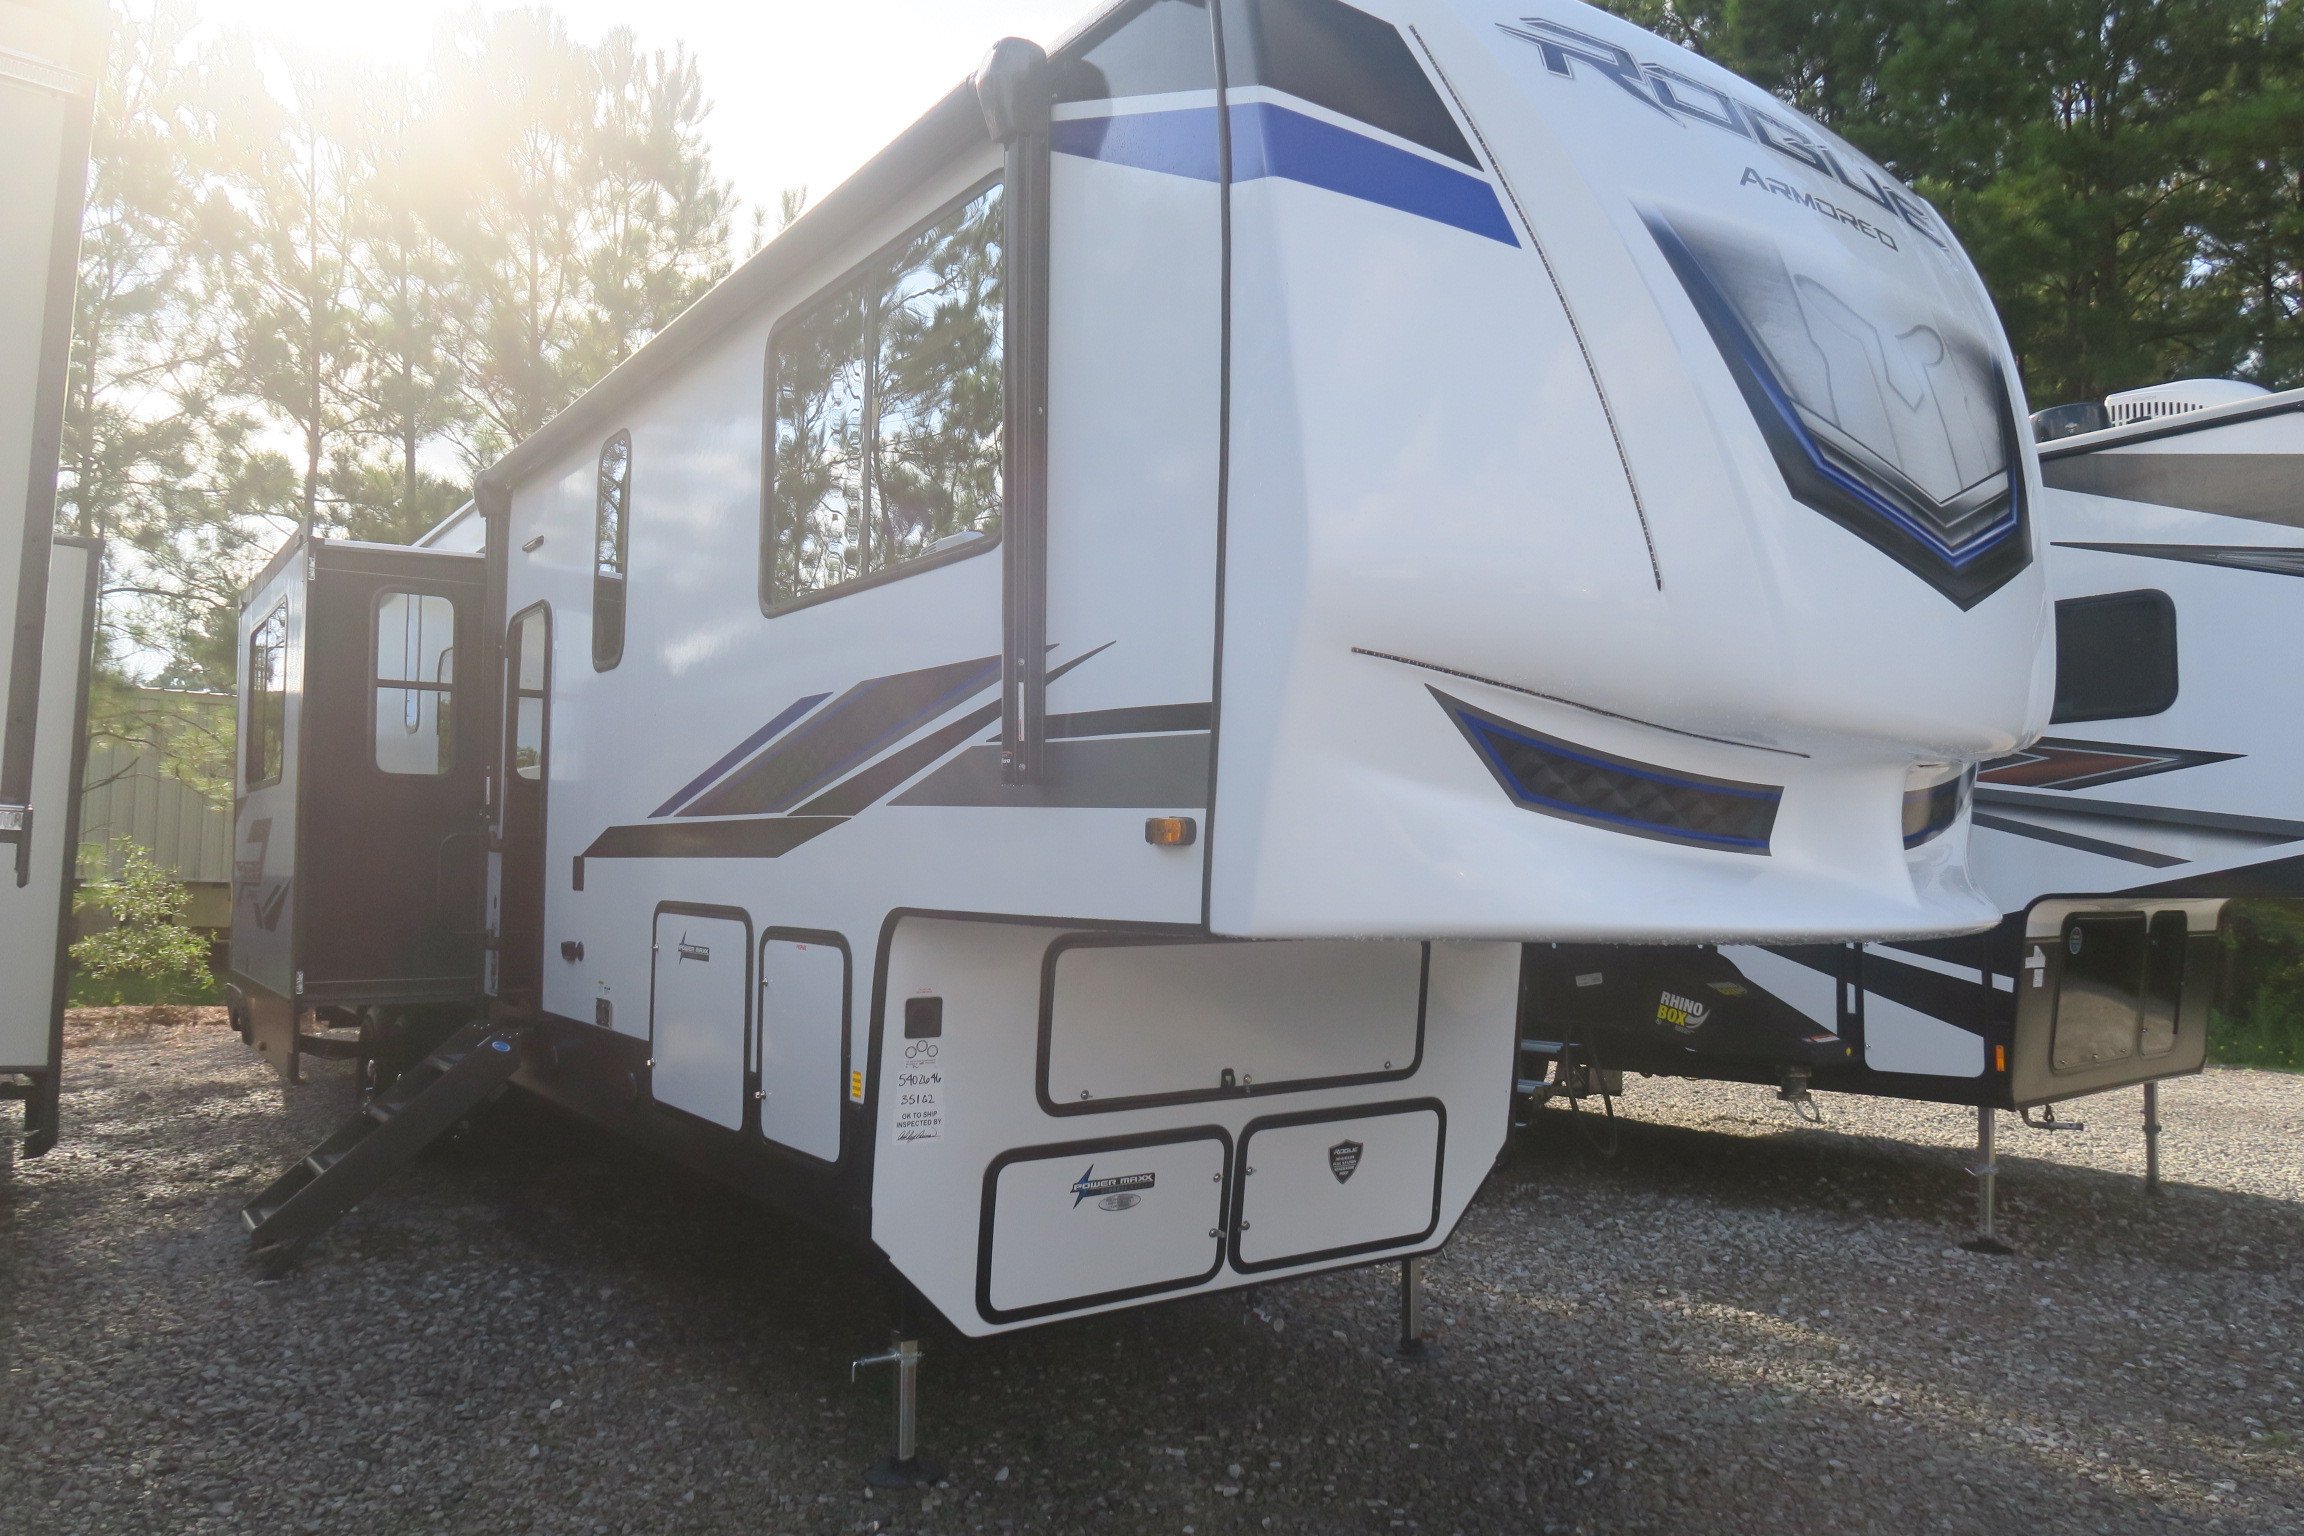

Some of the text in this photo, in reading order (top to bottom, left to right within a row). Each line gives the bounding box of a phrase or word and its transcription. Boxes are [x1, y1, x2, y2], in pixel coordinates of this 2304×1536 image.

[1660, 991, 1703, 1016] RHINO
[1657, 1005, 1687, 1026] BOX
[923, 1110, 938, 1118] SHIP
[896, 1120, 932, 1129] INSPECTED
[1073, 1180, 1116, 1190] POWER
[1120, 1174, 1153, 1184] MAXX
